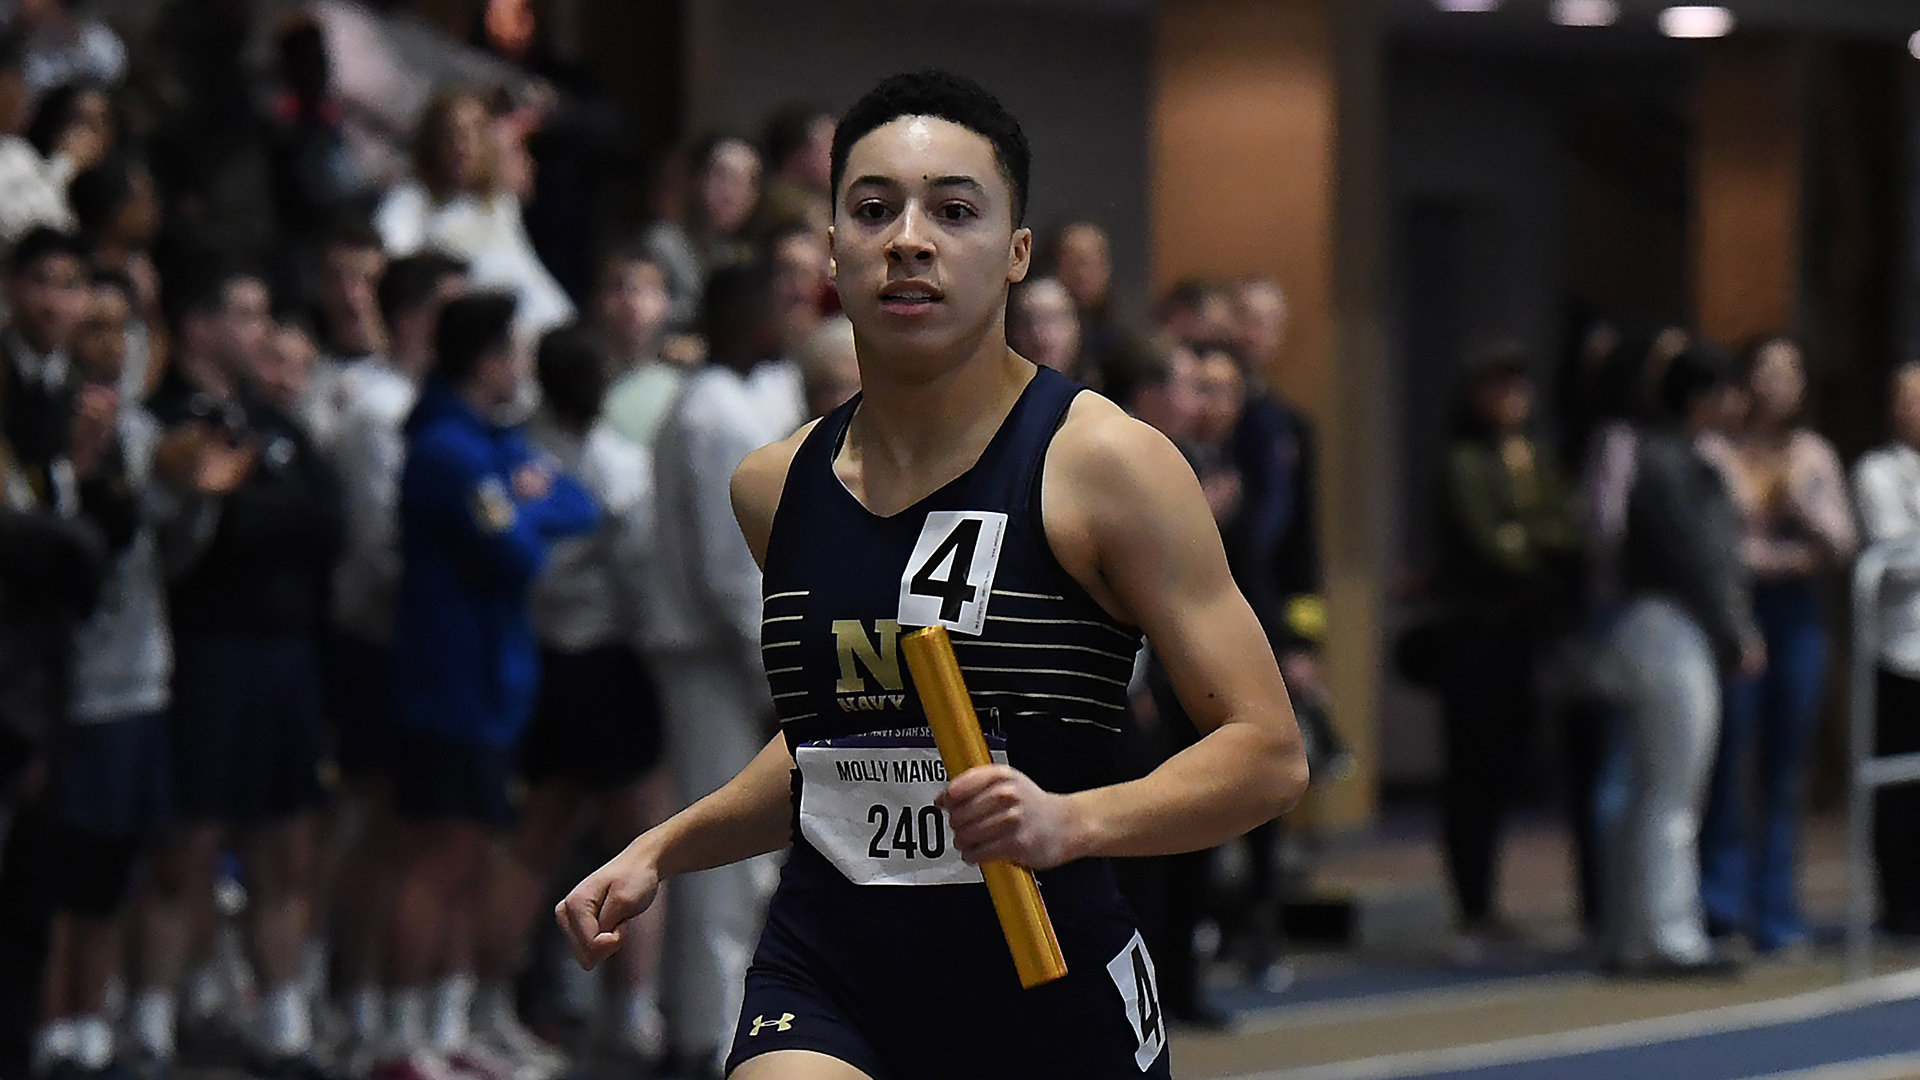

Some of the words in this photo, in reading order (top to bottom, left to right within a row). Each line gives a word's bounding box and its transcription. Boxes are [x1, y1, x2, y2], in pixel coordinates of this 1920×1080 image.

[909, 519, 982, 622] 4
[831, 619, 904, 693] N
[837, 695, 905, 712] NAVY
[920, 725, 934, 737] SE
[836, 760, 888, 782] MOLLY
[893, 760, 949, 783] MANG
[867, 804, 945, 860] 240
[1131, 943, 1161, 1047] 4
